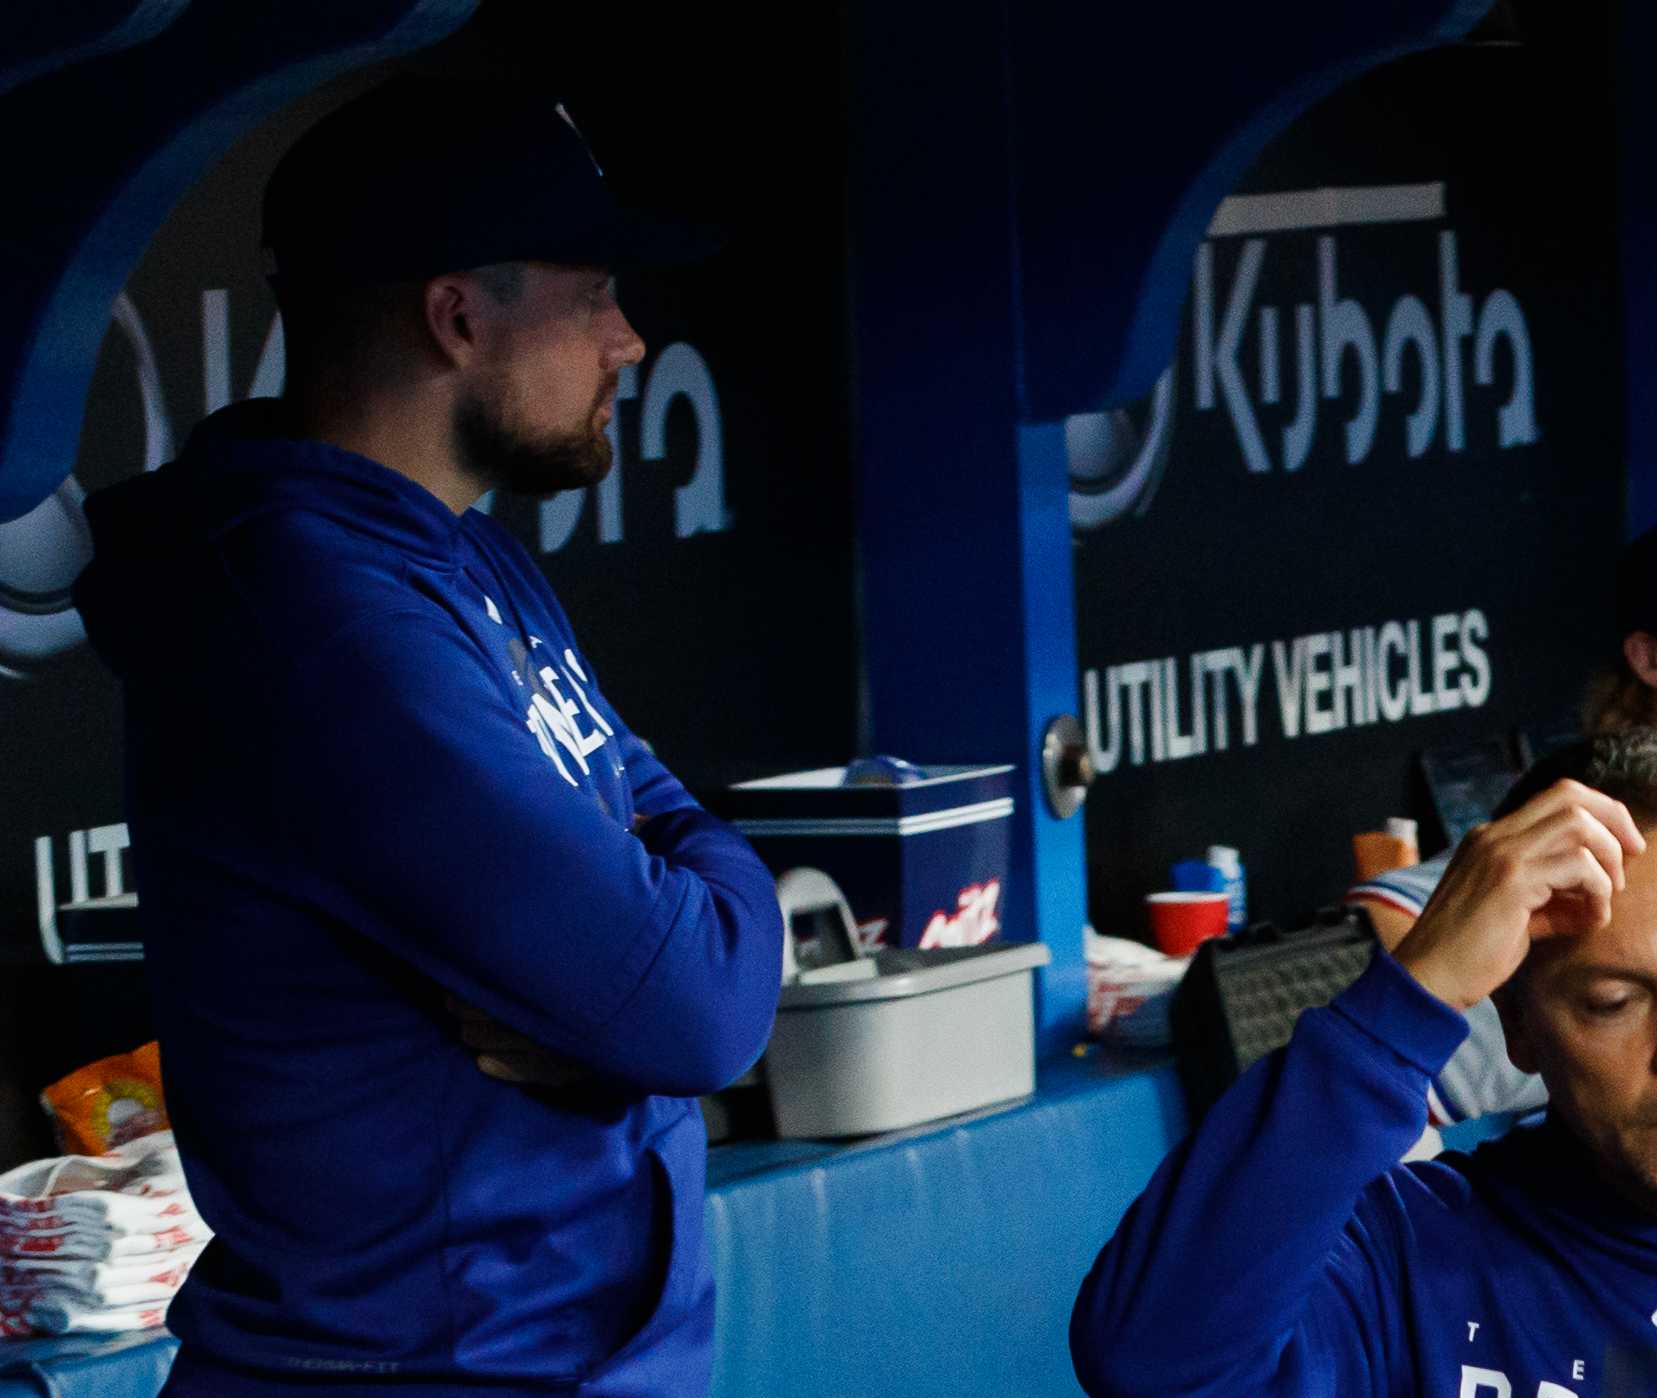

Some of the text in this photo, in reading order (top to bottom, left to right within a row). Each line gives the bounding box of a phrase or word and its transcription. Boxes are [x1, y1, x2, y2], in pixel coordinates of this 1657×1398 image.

[1194, 229, 1538, 474] Kubota
[1085, 609, 1491, 774] UTILITY VEHICLES
